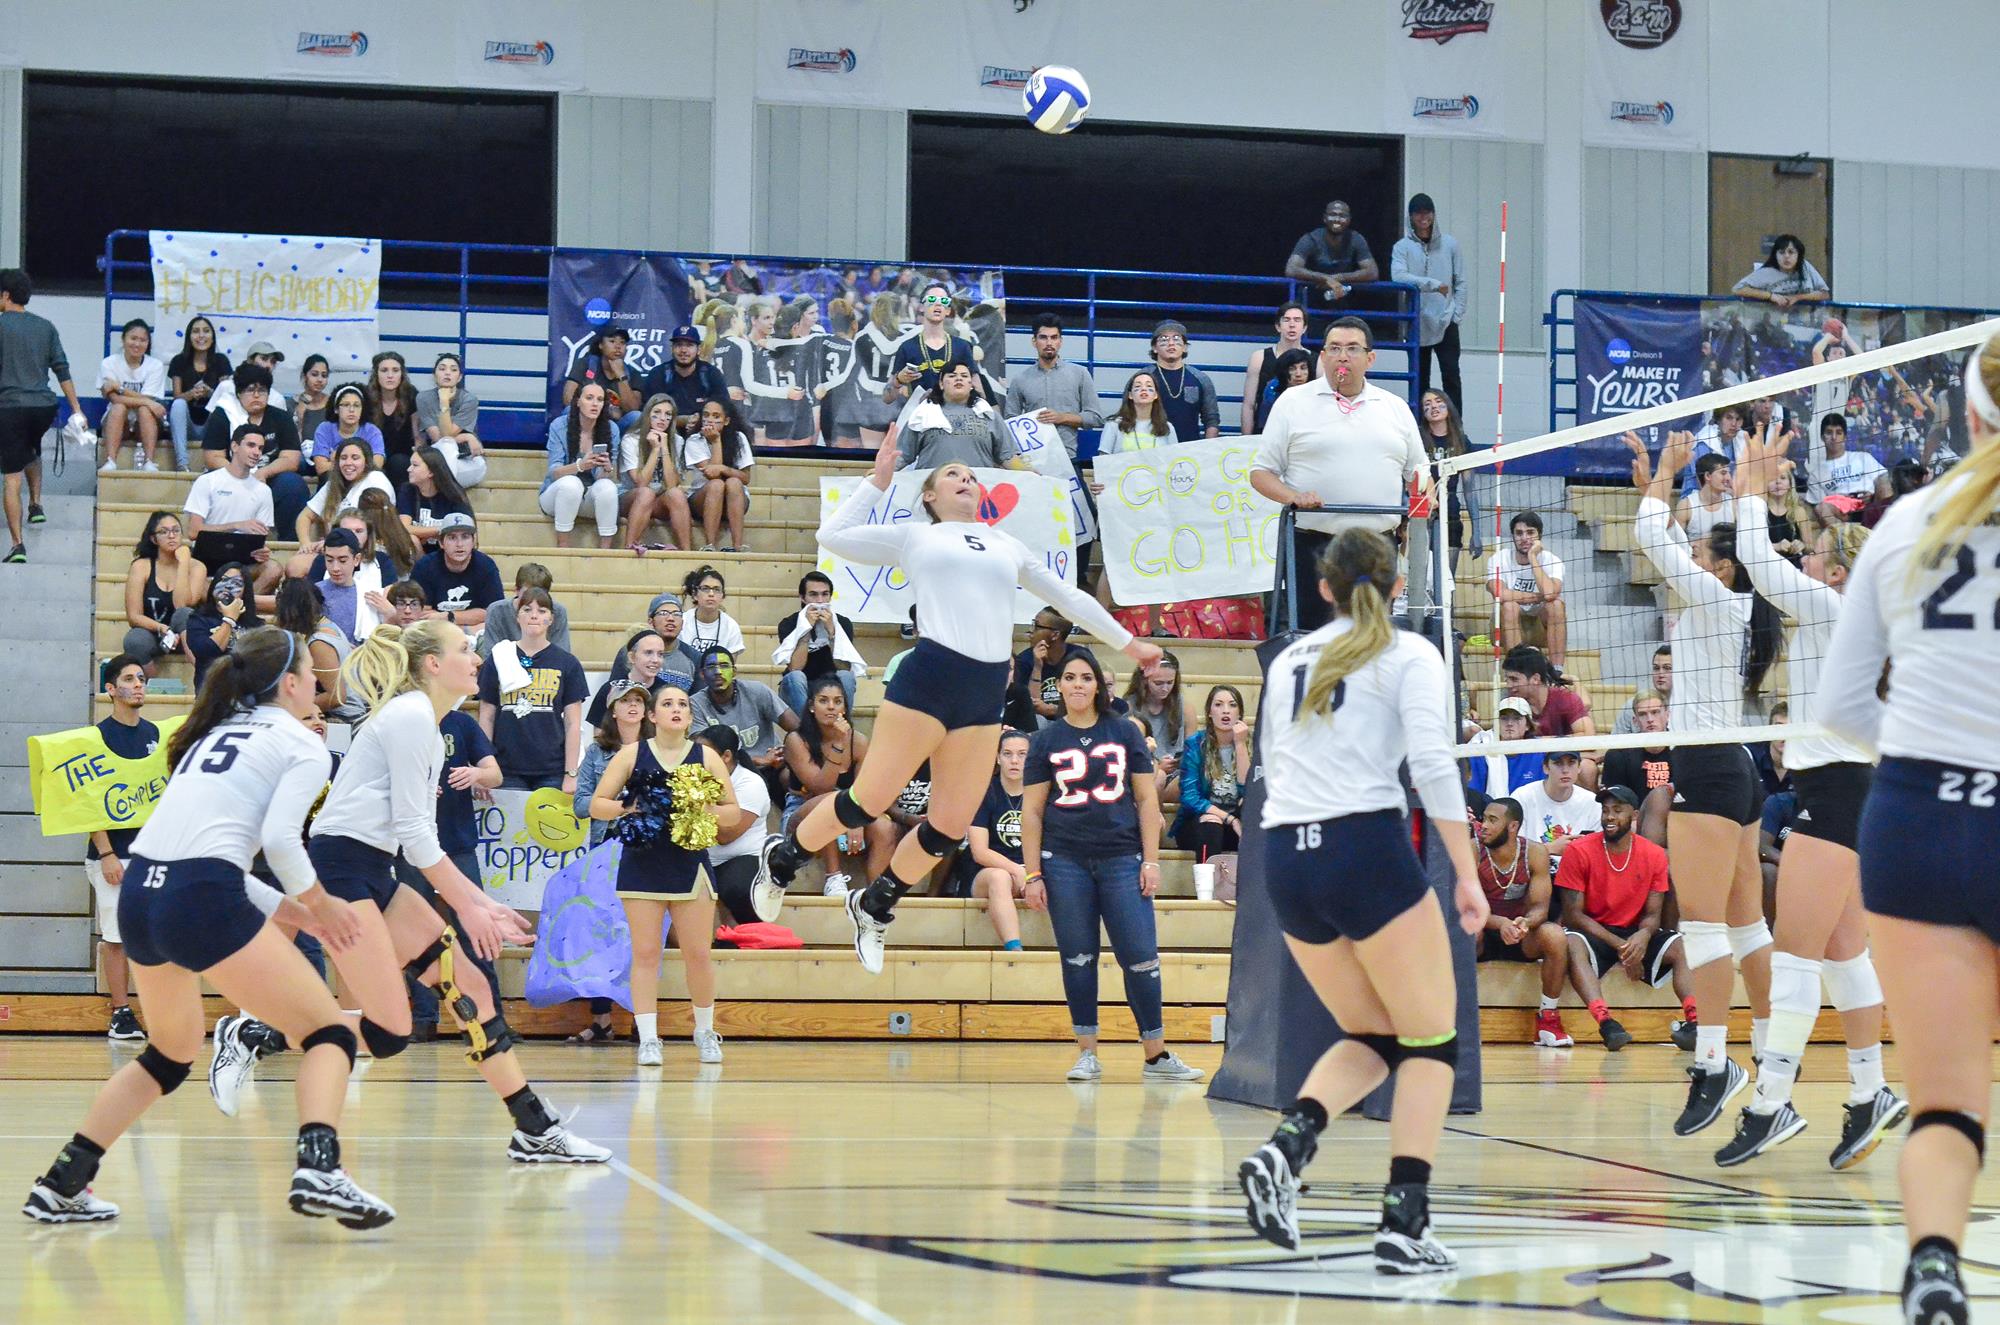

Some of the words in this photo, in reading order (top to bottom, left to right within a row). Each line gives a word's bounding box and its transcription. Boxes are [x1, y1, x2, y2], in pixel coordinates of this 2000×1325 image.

[1402, 0, 1495, 28] Patriots
[650, 330, 666, 341] IT
[561, 331, 664, 377] YRS
[1608, 351, 1631, 359] NCAA
[1622, 366, 1665, 380] MAKE
[1667, 368, 1681, 380] IT
[1587, 370, 1680, 415] YOURS
[1118, 456, 1200, 510] GO
[1211, 487, 1257, 515] OR
[964, 535, 986, 551] 5
[1130, 524, 1205, 577] GO
[1223, 514, 1281, 568] HO
[1514, 578, 1537, 593] SEU
[178, 732, 253, 774] 15
[52, 753, 115, 792] THE
[1049, 742, 1127, 808] 23
[1938, 771, 1998, 808] 22
[1296, 822, 1323, 851] 16
[143, 865, 168, 889] 15
